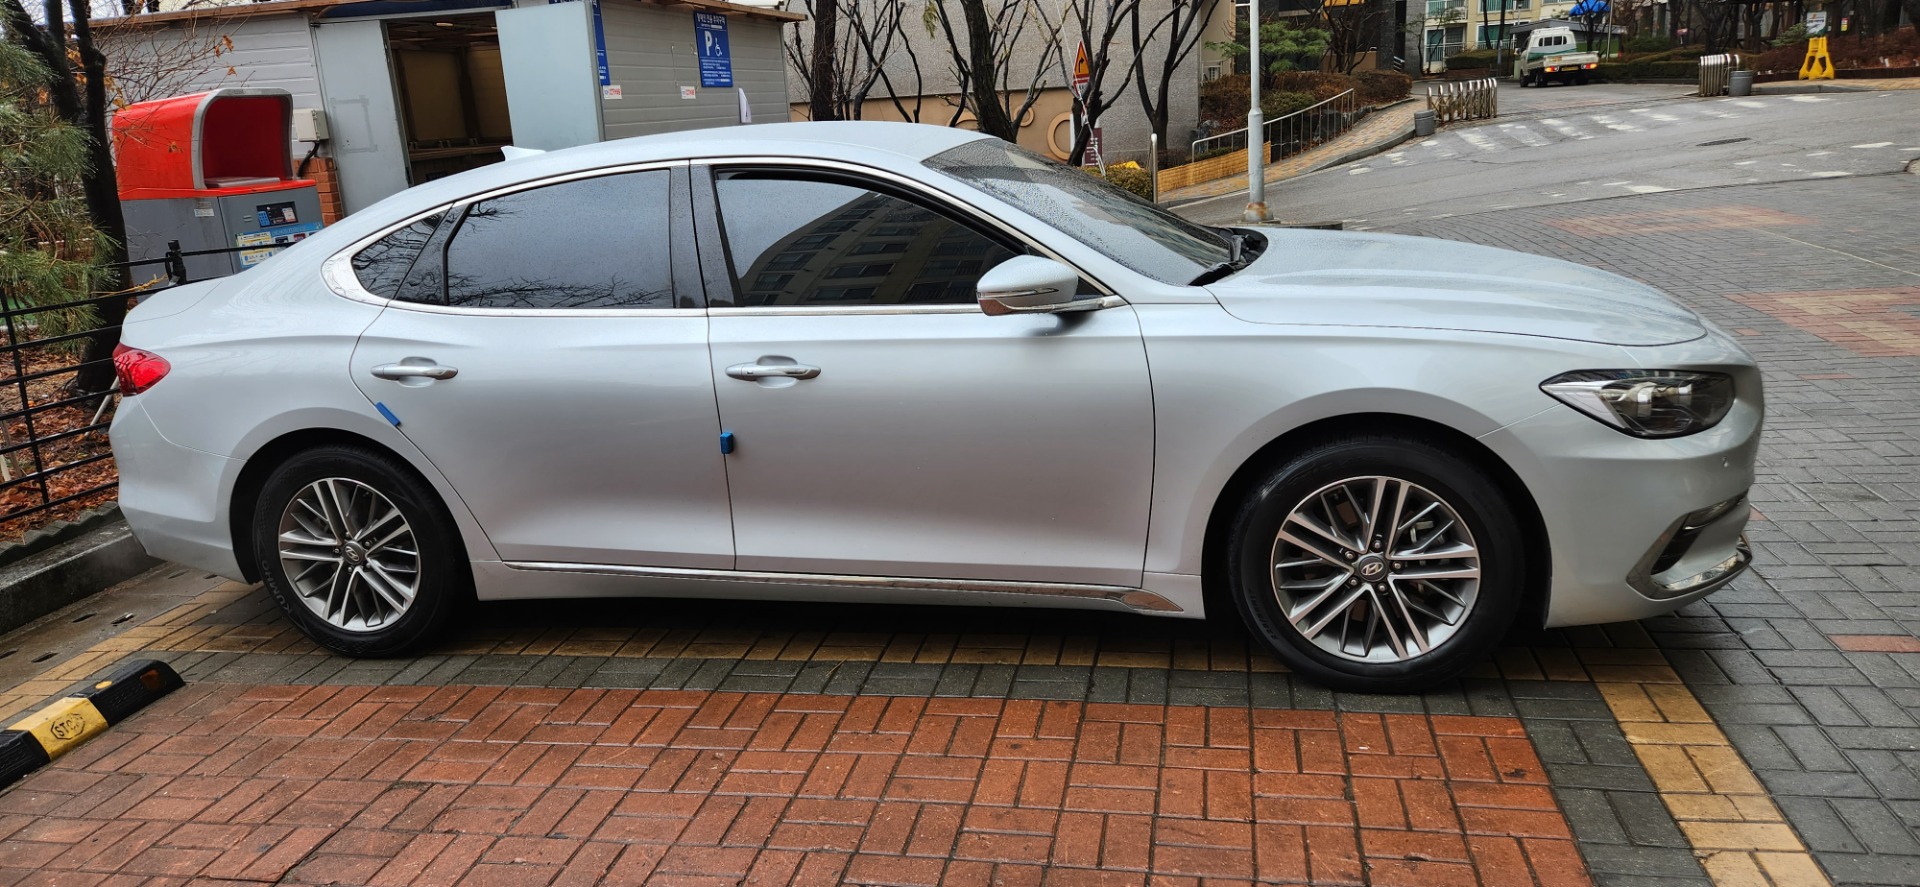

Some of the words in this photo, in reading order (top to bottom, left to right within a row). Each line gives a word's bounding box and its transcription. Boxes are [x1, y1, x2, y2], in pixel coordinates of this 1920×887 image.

[705, 30, 713, 56] P
[262, 560, 292, 613] KUMHO
[54, 717, 80, 737] STO
